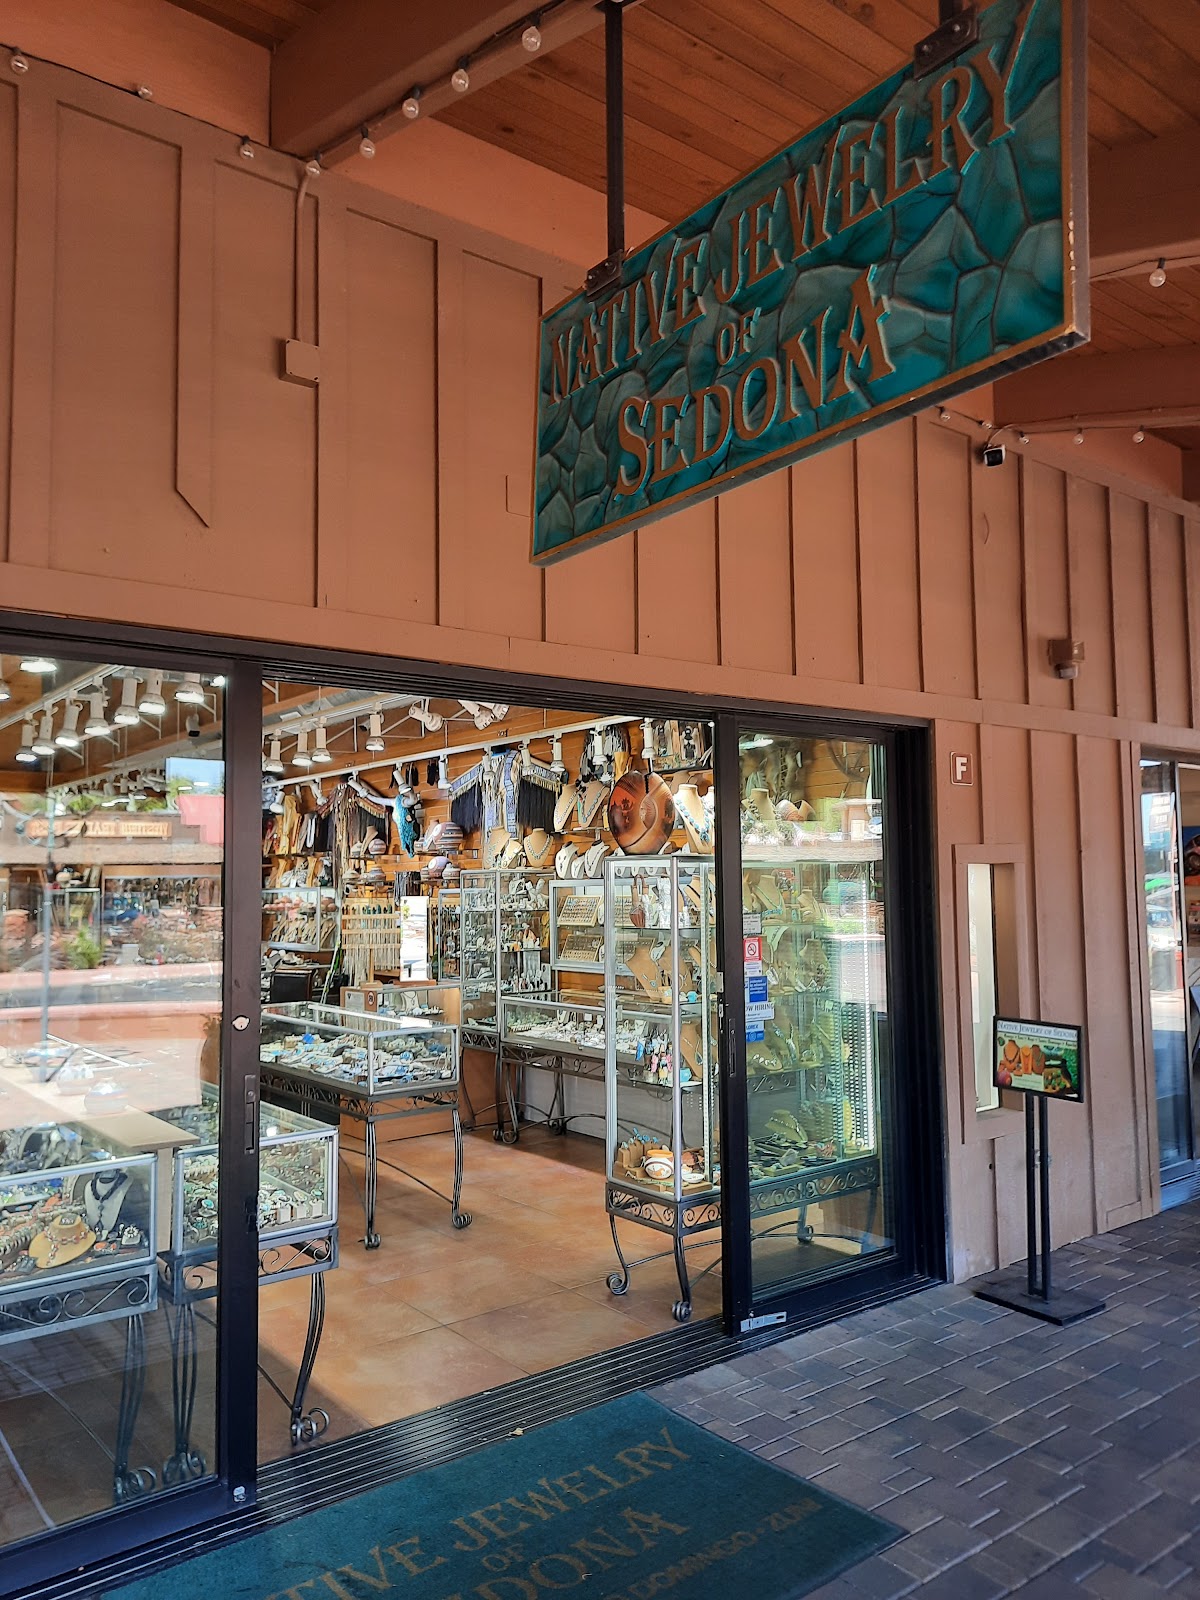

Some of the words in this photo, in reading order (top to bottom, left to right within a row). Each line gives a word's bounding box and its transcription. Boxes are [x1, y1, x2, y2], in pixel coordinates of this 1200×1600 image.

[548, 237, 708, 406] NATIVE
[712, 0, 1040, 303] JEWELRY
[614, 264, 897, 499] SEDONA
[716, 306, 762, 367] OF
[955, 756, 968, 781] F
[450, 1427, 691, 1552] JEWELRY
[443, 1506, 691, 1600] DONA
[481, 1543, 525, 1573] OF
